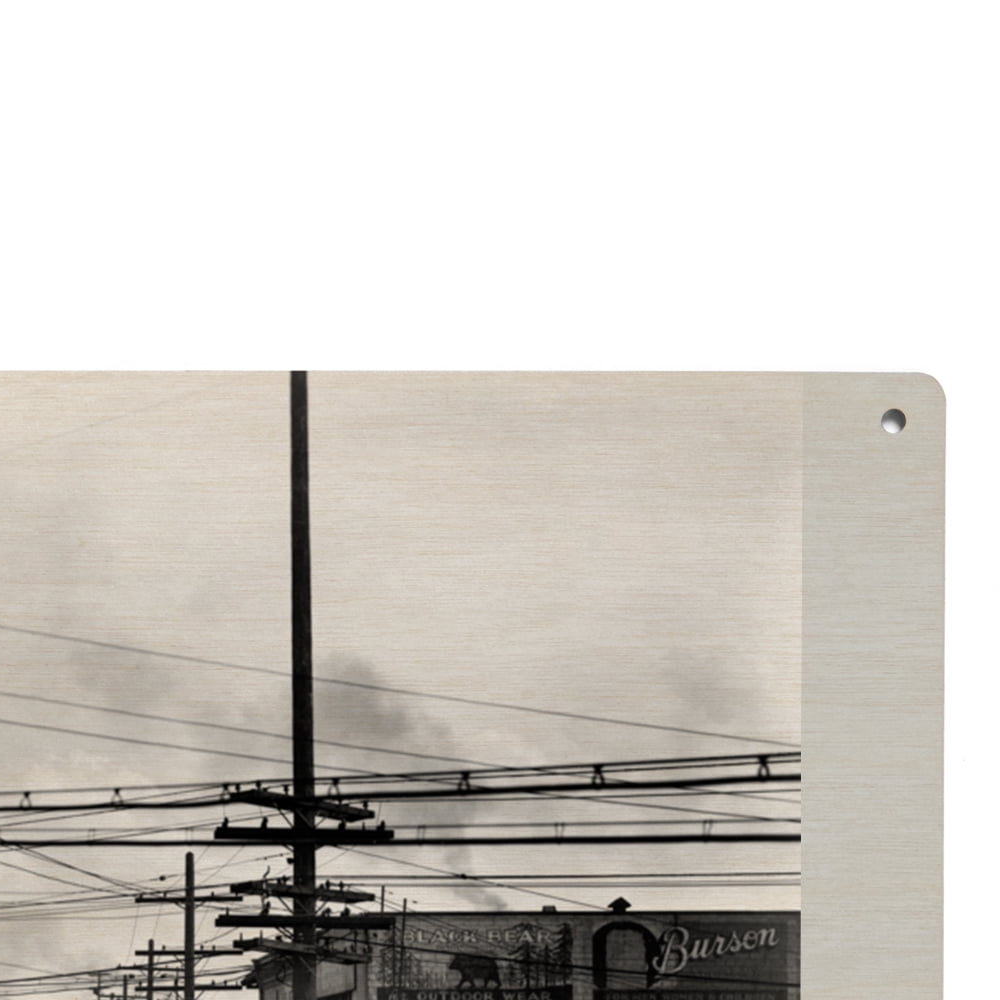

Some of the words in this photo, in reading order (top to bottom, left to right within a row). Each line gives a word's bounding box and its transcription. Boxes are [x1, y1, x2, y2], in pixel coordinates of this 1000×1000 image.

[405, 930, 477, 943] BLACK
[488, 930, 552, 943] BEAR
[652, 926, 779, 974] Burson
